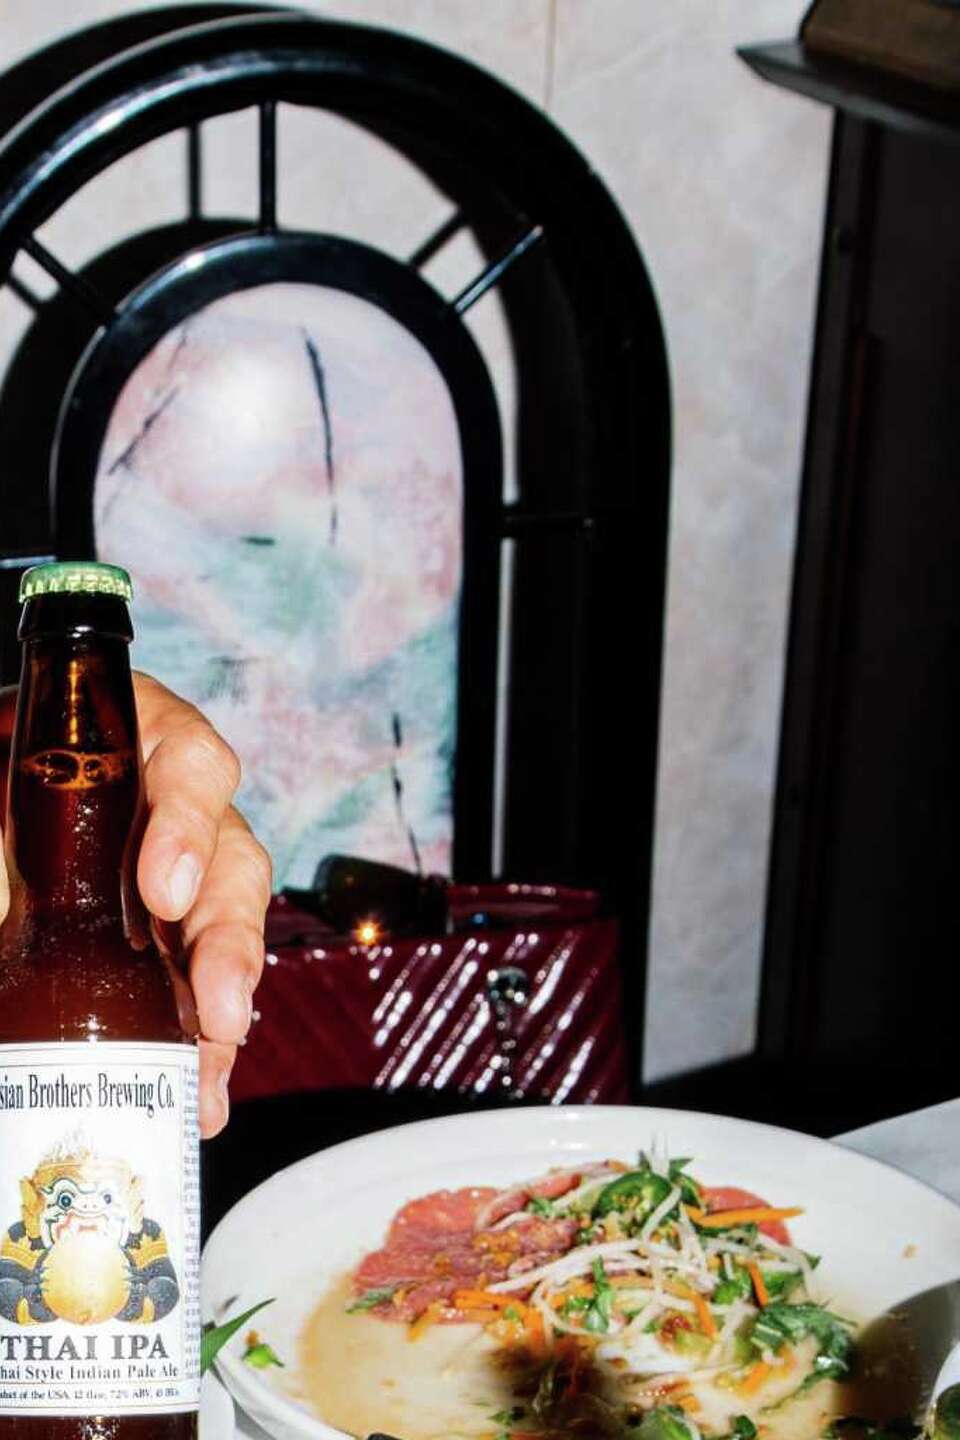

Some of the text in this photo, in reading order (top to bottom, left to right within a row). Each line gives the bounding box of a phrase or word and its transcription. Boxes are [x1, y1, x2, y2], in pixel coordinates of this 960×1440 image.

[28, 1073, 92, 1109] Brothers
[98, 1072, 155, 1119] Brewing
[157, 1072, 175, 1109] Co.
[0, 1333, 170, 1361] THAI IPA
[24, 1364, 64, 1384] Style
[69, 1364, 121, 1380] Indian
[127, 1364, 156, 1379] Pale
[160, 1362, 178, 1377] Ale
